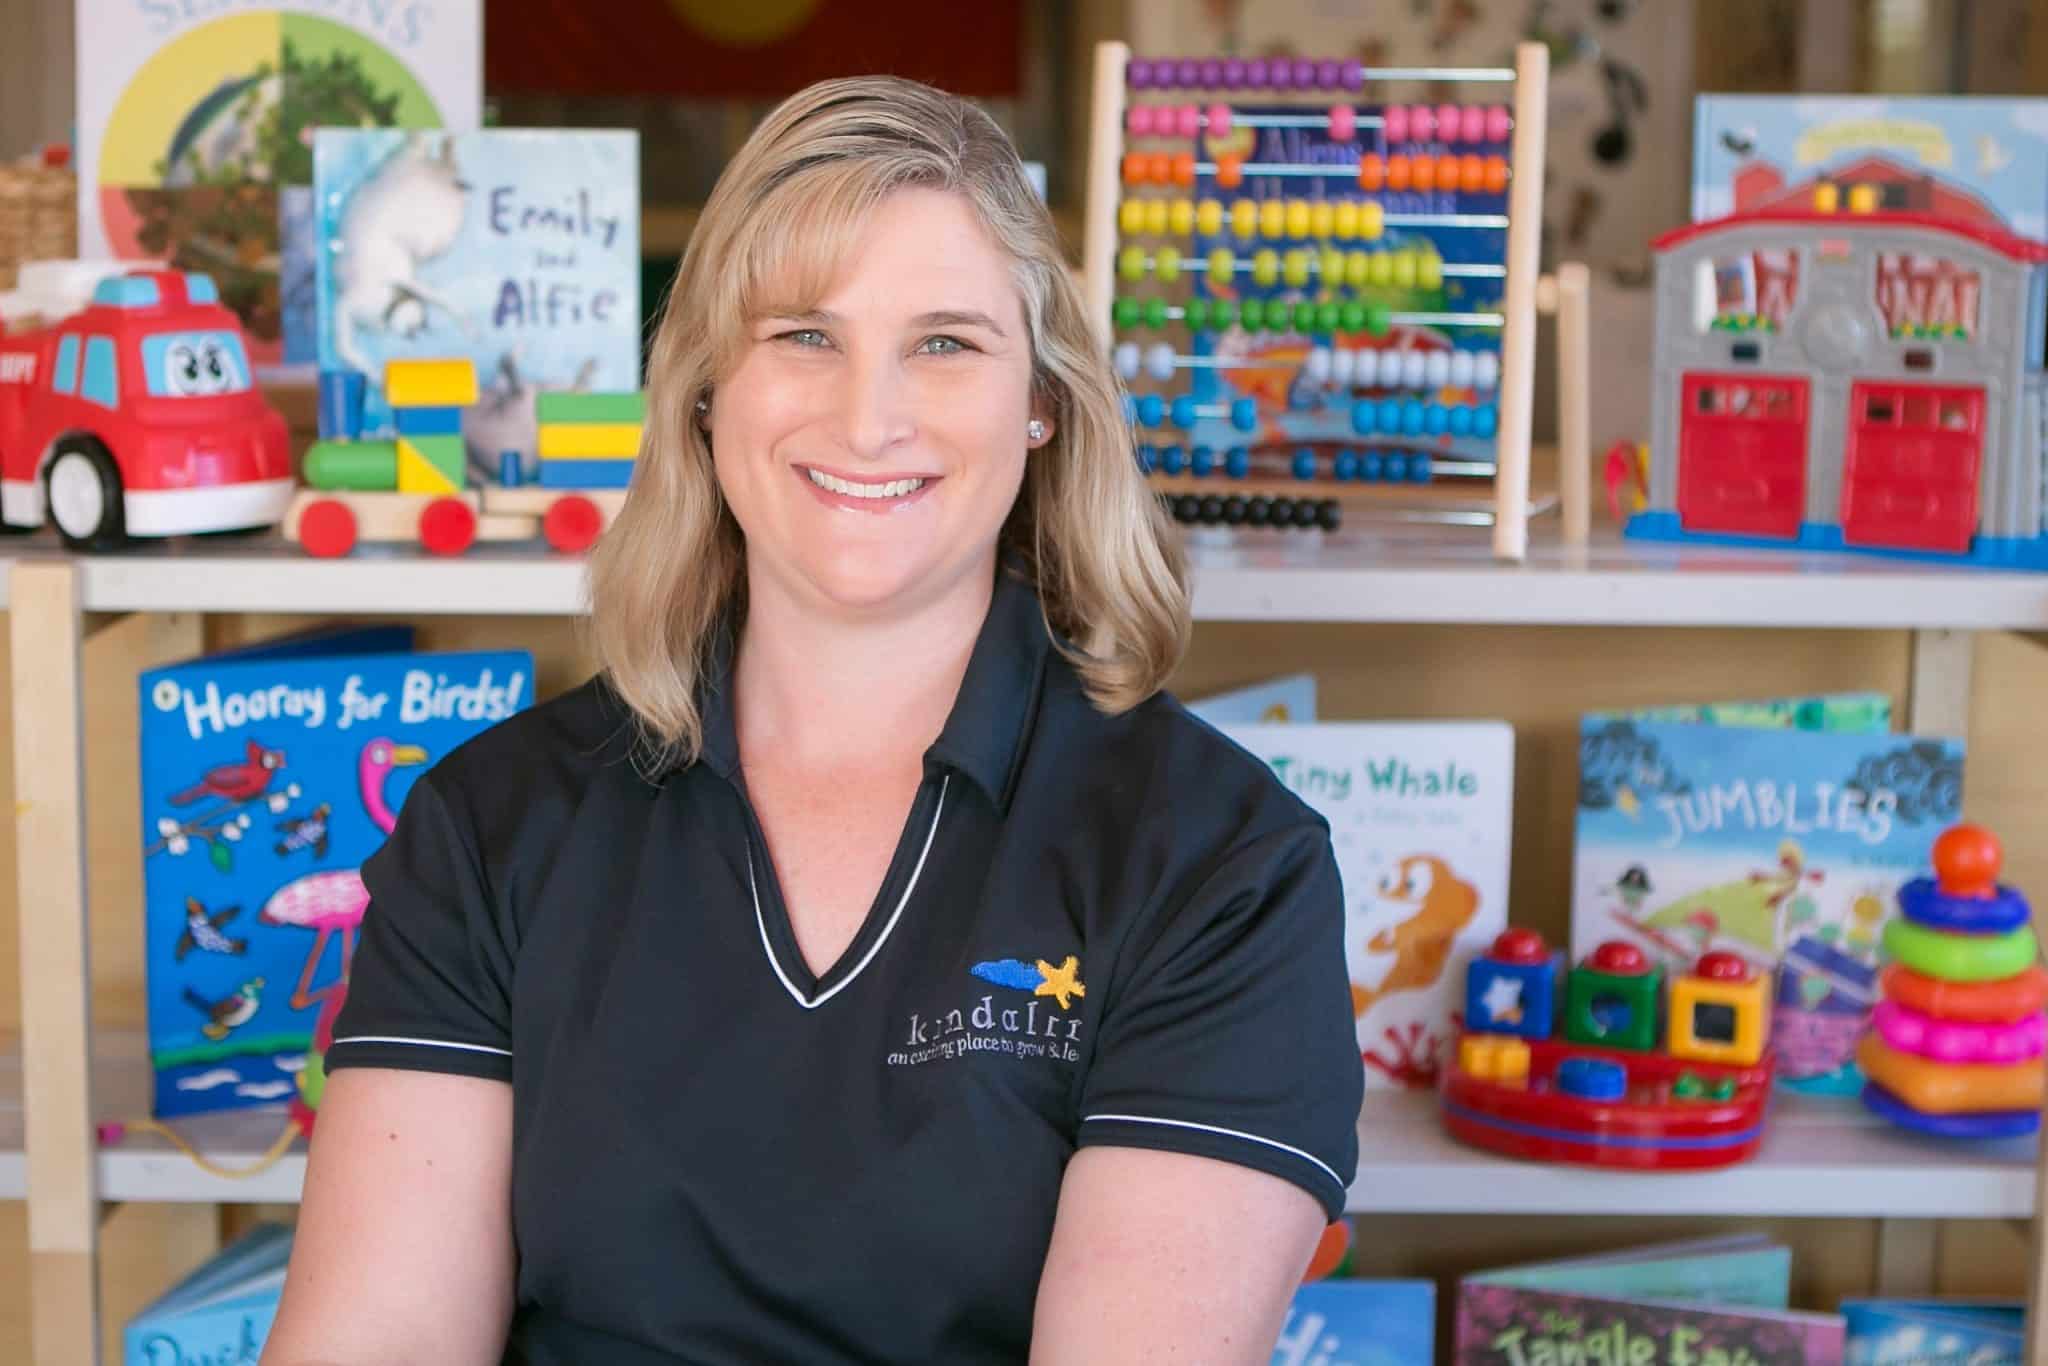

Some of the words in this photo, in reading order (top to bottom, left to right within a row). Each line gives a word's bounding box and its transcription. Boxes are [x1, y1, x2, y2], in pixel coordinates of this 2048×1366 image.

[490, 184, 620, 248] Emily
[493, 278, 618, 327] Alfie
[182, 680, 327, 740] Hooray
[338, 673, 390, 730] for
[401, 668, 525, 723] Birds!
[1269, 755, 1353, 799] Tiny
[1367, 755, 1480, 798] Whale
[1654, 776, 1900, 849] JUMBLIES
[887, 1051, 909, 1065] an
[956, 1032, 1000, 1056] place
[1048, 1041, 1061, 1059] &
[1062, 1041, 1081, 1062] le
